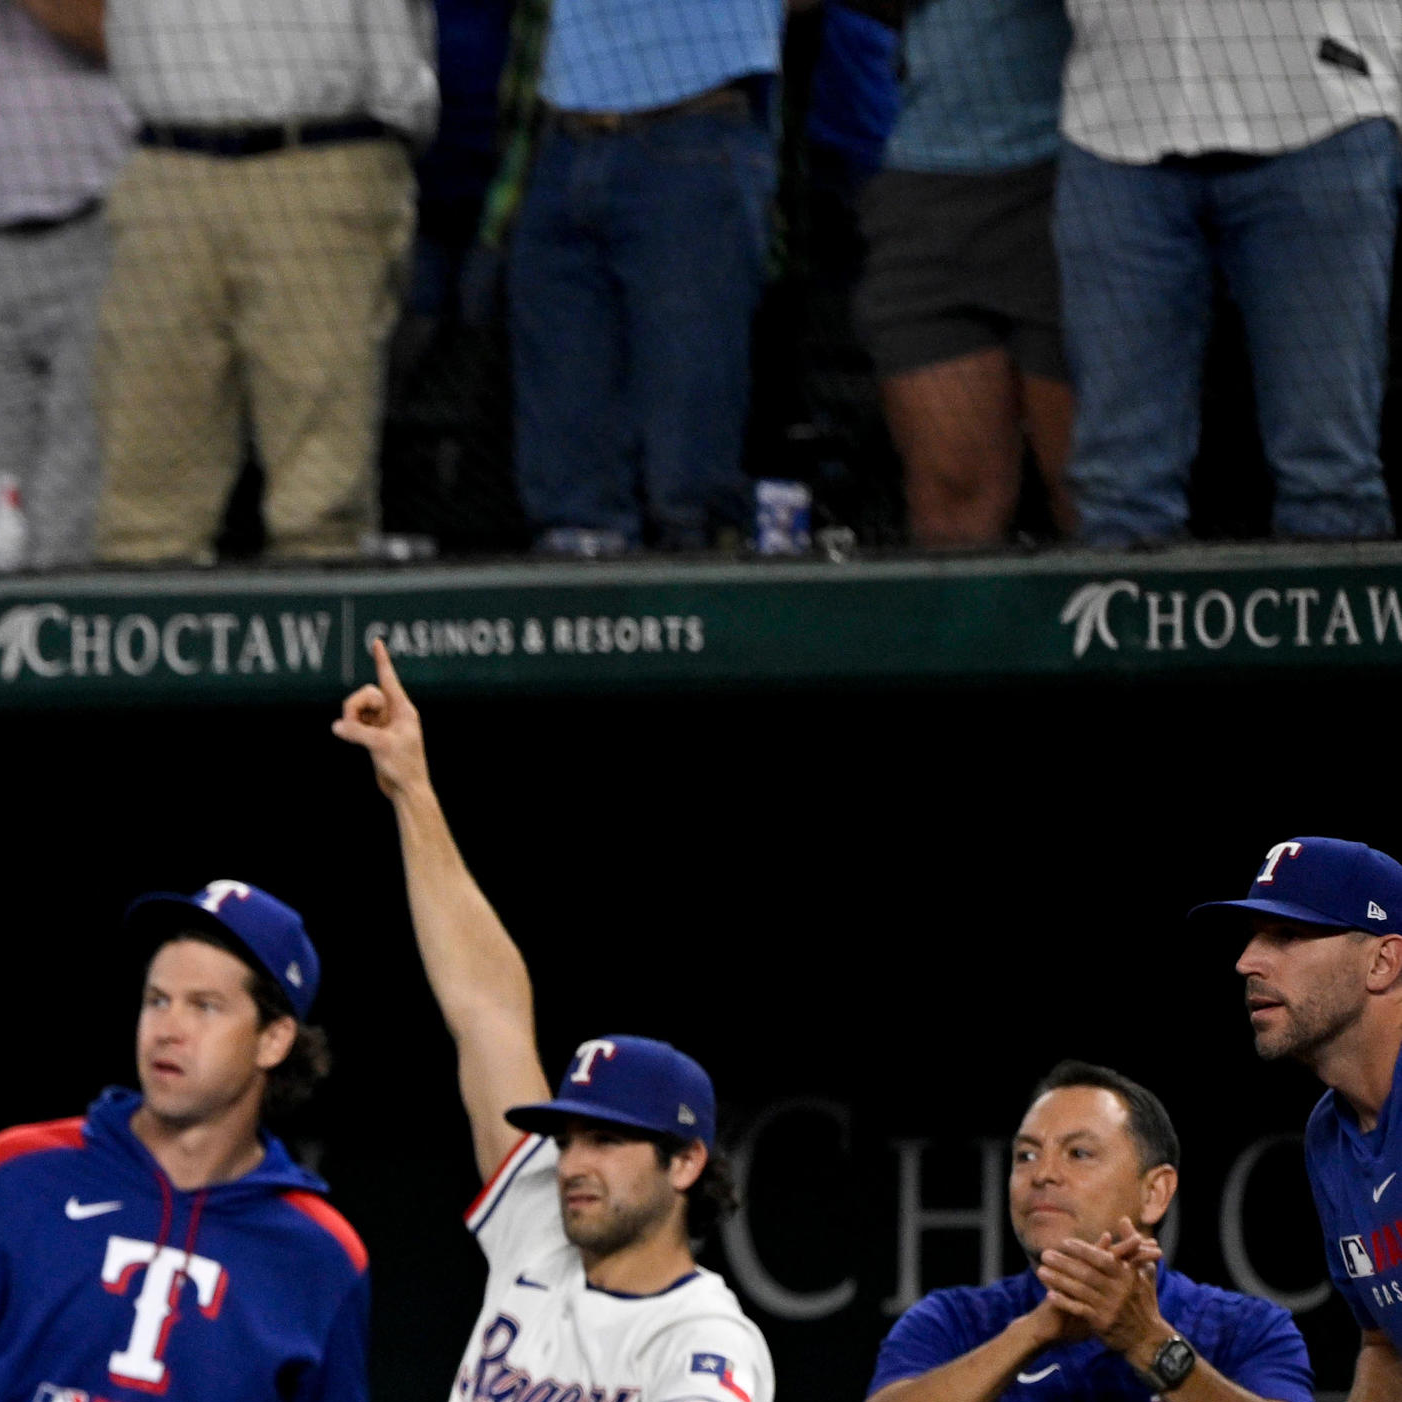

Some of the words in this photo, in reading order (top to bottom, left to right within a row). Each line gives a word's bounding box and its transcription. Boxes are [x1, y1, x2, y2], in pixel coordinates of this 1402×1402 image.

[18, 605, 331, 678] CHOCTAW
[364, 618, 516, 657] CASINOS
[523, 616, 546, 655] &
[552, 614, 705, 654] RESORTS
[1256, 841, 1303, 886] T
[570, 1038, 617, 1085] T
[101, 1234, 230, 1397] T
